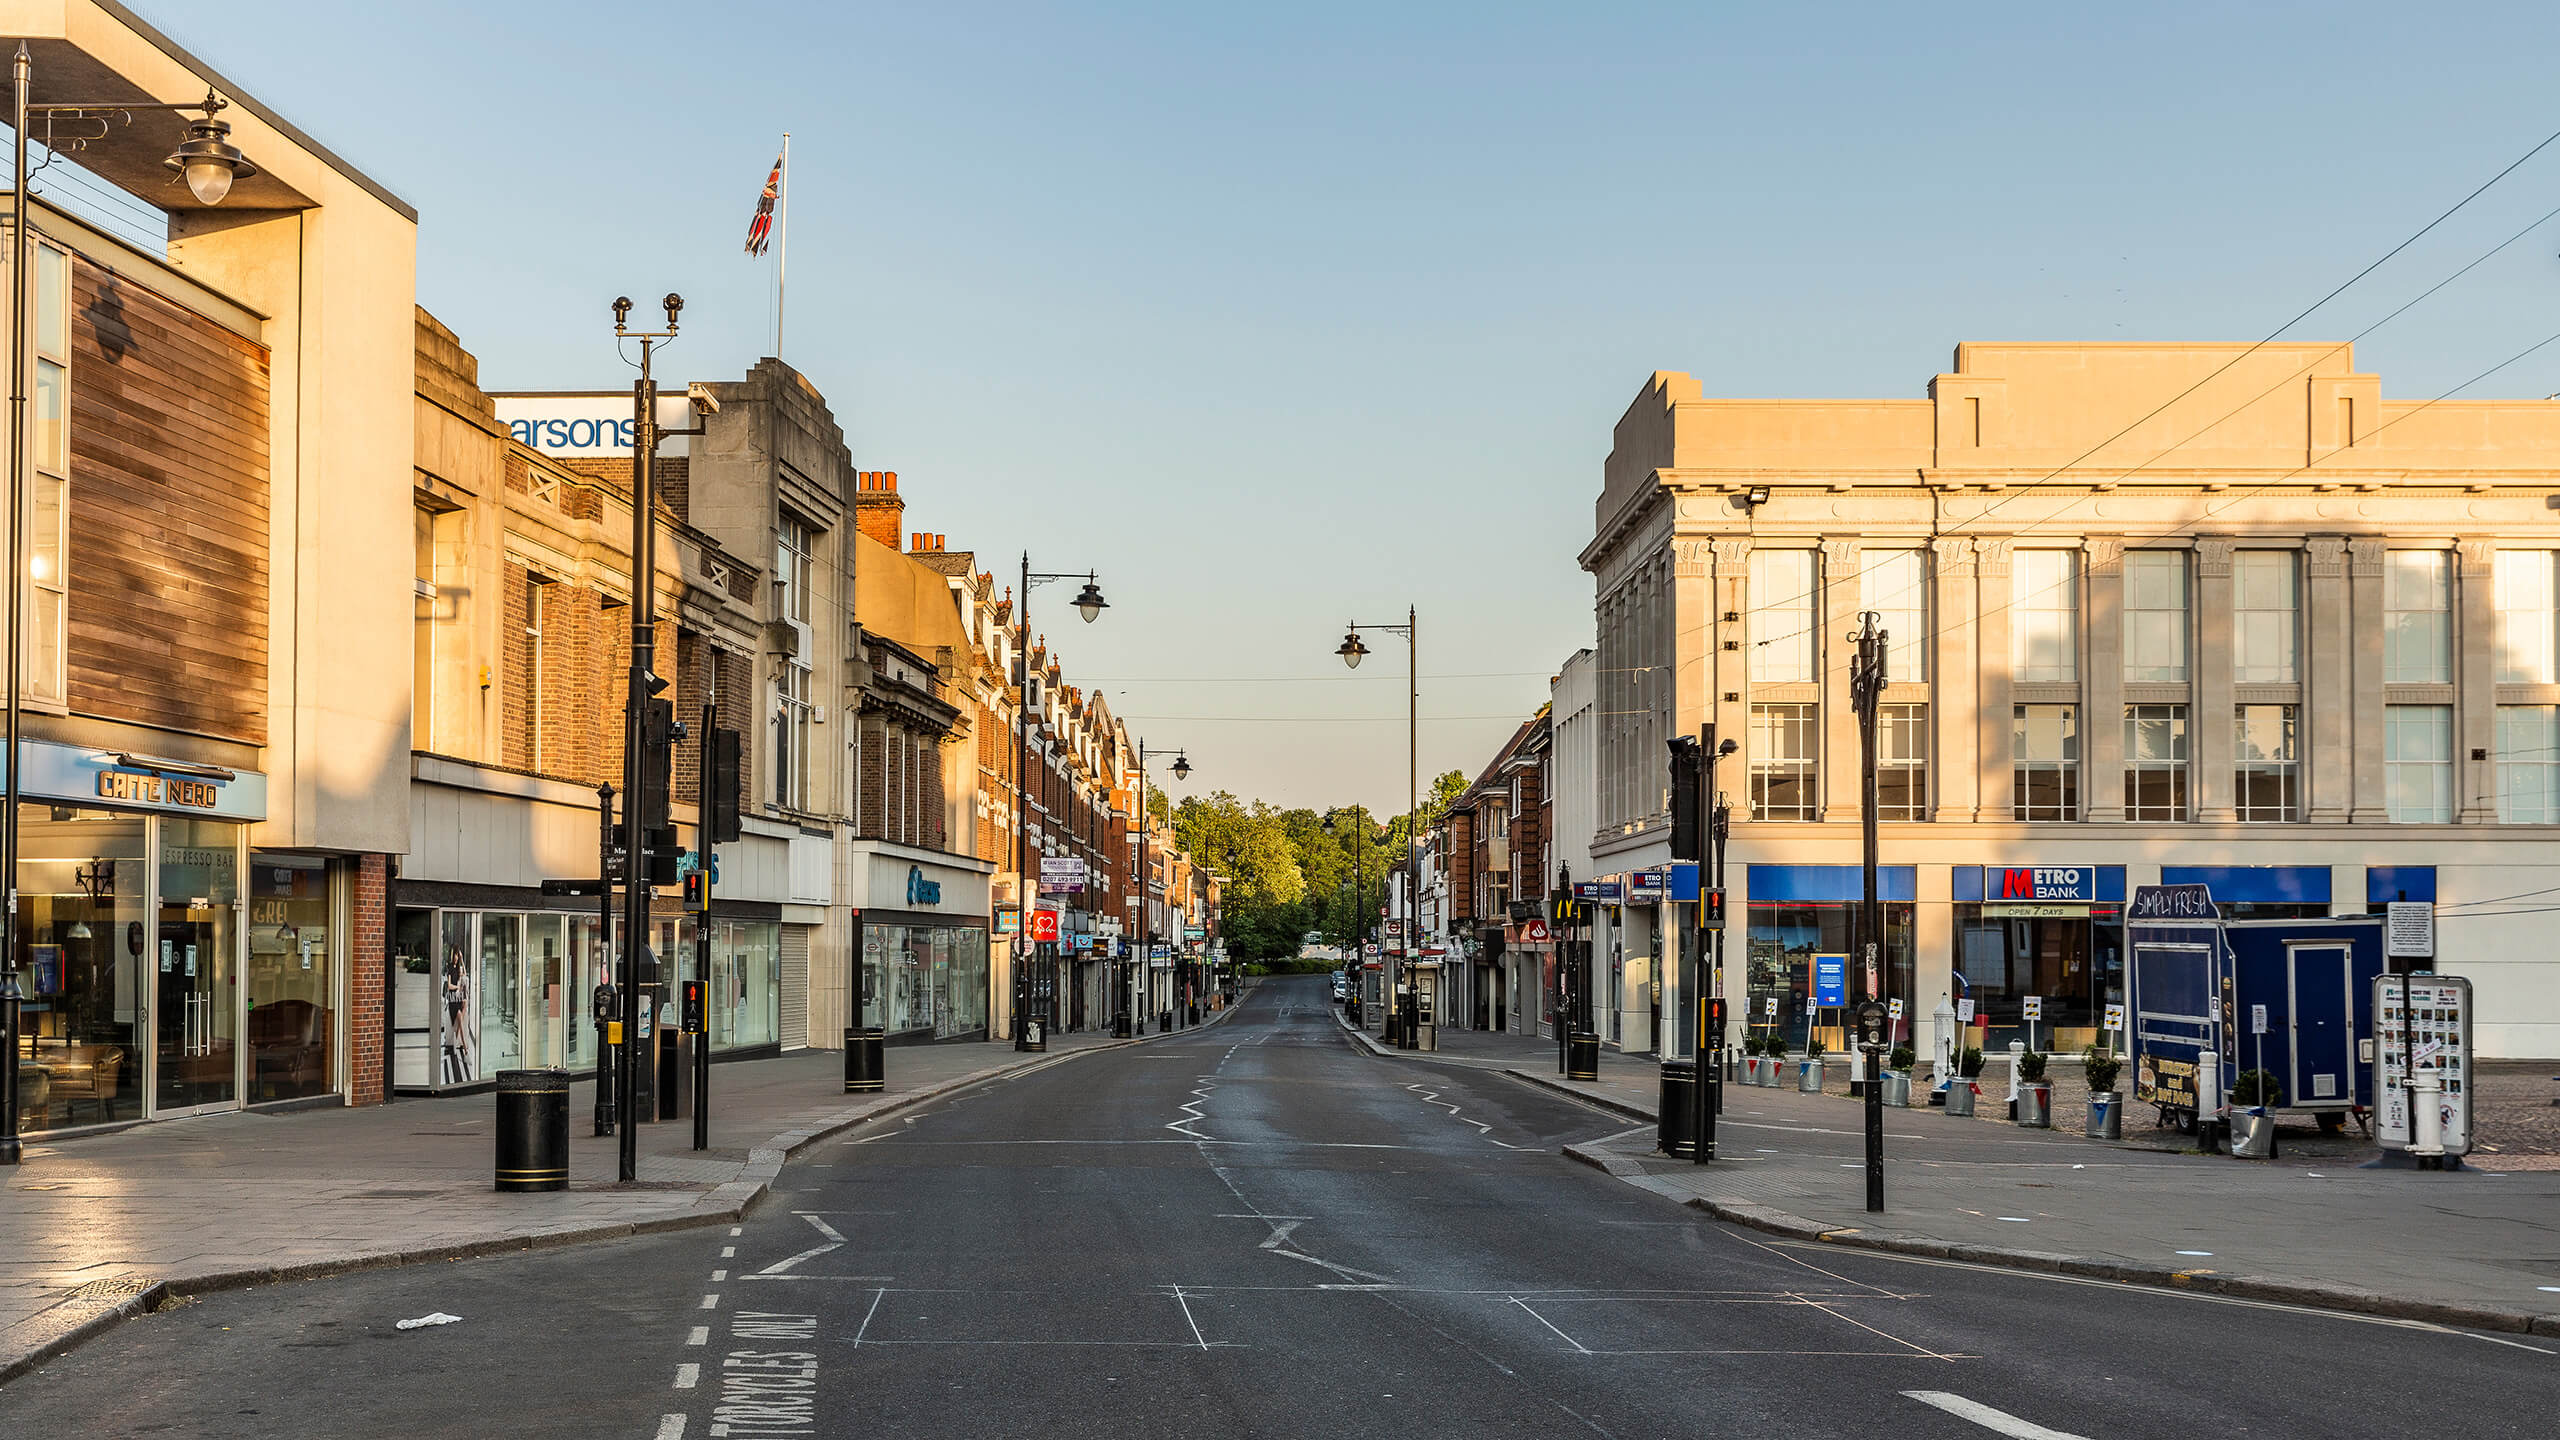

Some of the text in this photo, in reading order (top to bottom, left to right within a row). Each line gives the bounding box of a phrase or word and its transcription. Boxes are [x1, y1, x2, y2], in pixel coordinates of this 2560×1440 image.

[496, 418, 635, 447] arsons
[100, 771, 216, 808] CAFFE NERO
[165, 850, 233, 868] ESPRESSO BAR
[1634, 874, 1662, 886] METRO
[2002, 869, 2080, 898] METRO
[2036, 887, 2079, 898] BANK
[2008, 906, 2064, 916] OPEN 7 DAYS
[2137, 890, 2206, 916] SIMPLY FRESH
[709, 1311, 818, 1440] TORCYCLES ONLY
